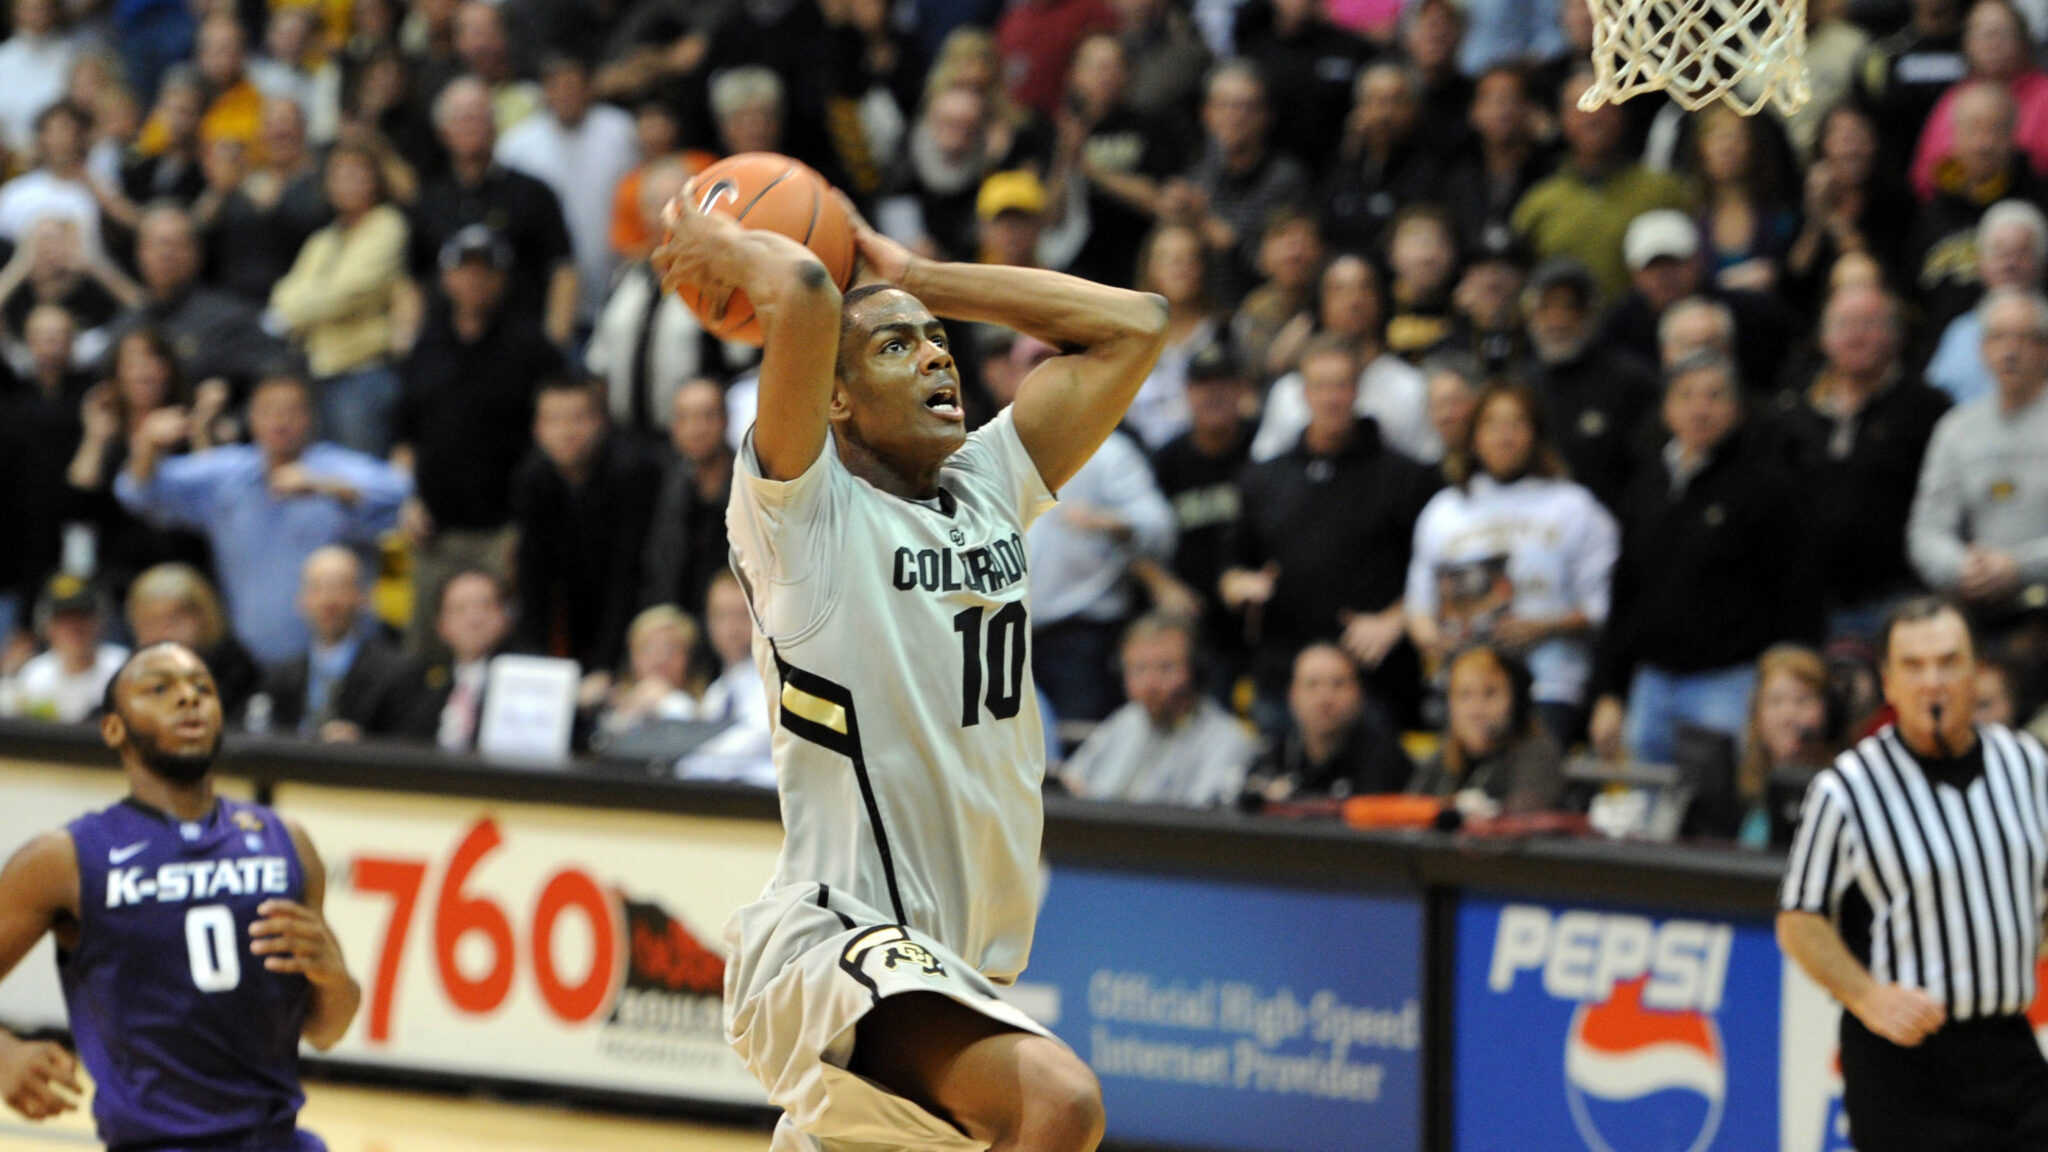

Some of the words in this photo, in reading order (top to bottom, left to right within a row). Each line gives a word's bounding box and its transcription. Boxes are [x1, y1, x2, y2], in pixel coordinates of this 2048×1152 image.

[953, 600, 1028, 728] 10
[106, 857, 288, 908] K-STATE
[352, 818, 613, 1042] 760
[185, 903, 241, 993] 0
[1488, 903, 1734, 1013] PEPSI
[1088, 969, 1216, 1030] Official
[1219, 981, 1421, 1065] High-Speed
[1090, 1024, 1229, 1086] Internet
[1233, 1038, 1385, 1102] Provider
